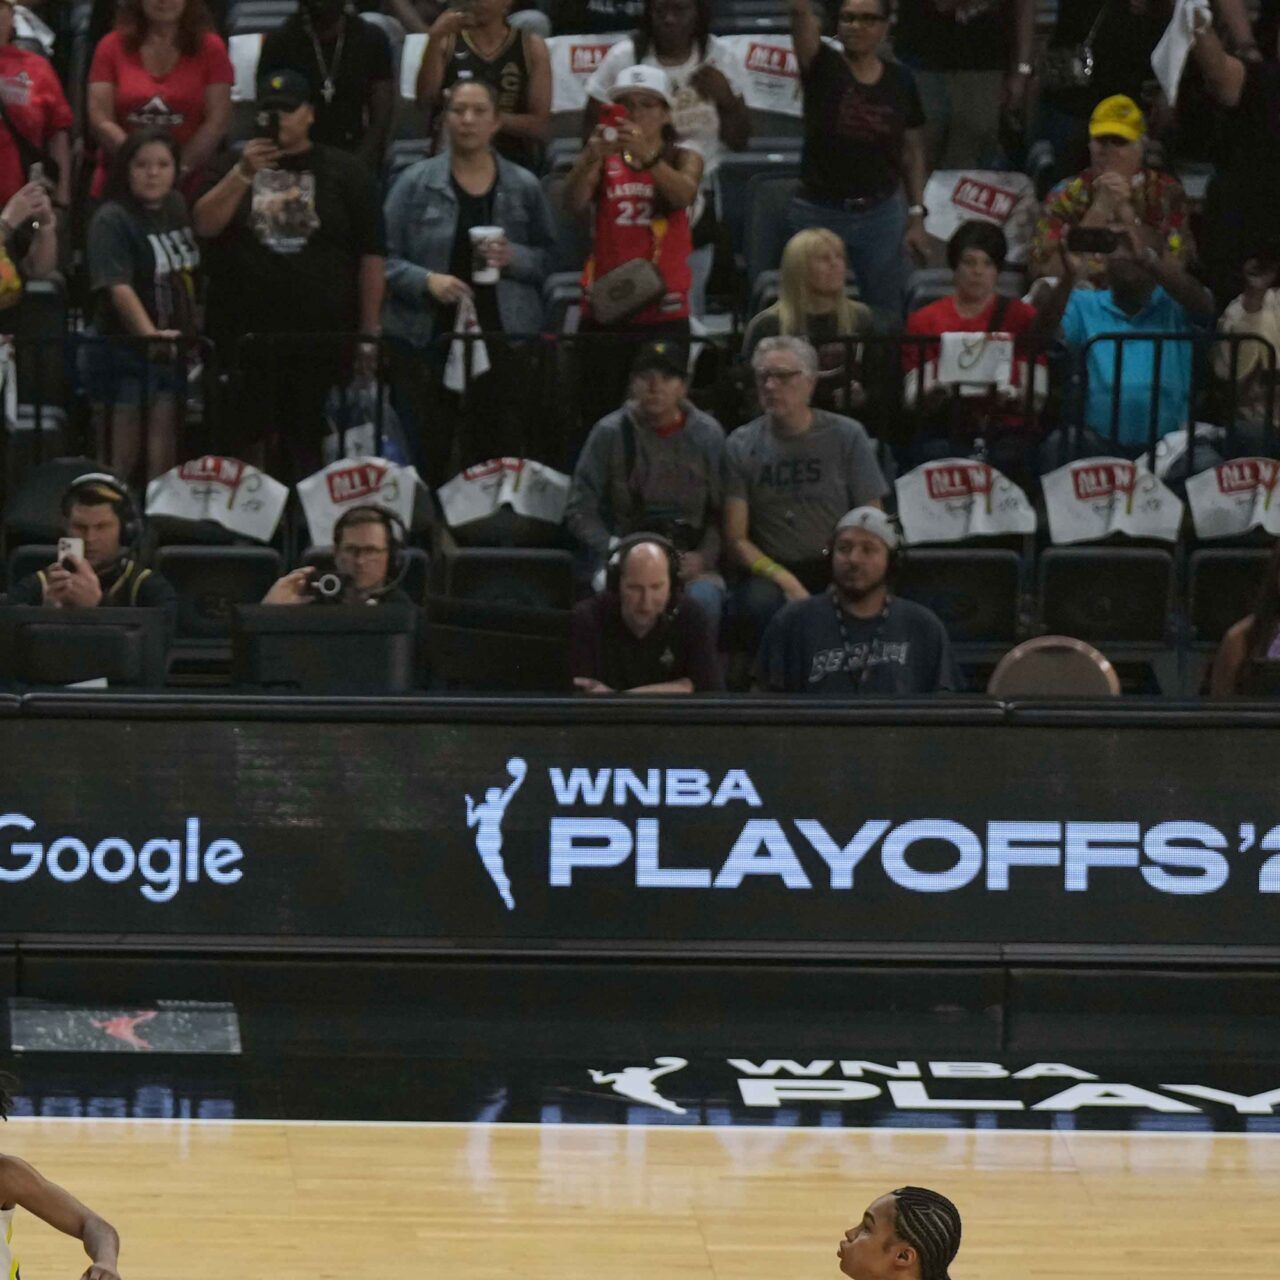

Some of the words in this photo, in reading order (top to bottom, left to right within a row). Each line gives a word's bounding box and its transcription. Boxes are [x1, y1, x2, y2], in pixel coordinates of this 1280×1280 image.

[957, 180, 990, 210] ALL
[615, 201, 653, 226] 22
[329, 471, 368, 501] ALL
[930, 469, 971, 498] ALL
[1076, 469, 1113, 497] ALL
[549, 767, 763, 807] WNBA
[549, 816, 1280, 897] PLAYOFFS'
[726, 1058, 1099, 1080] WNBA
